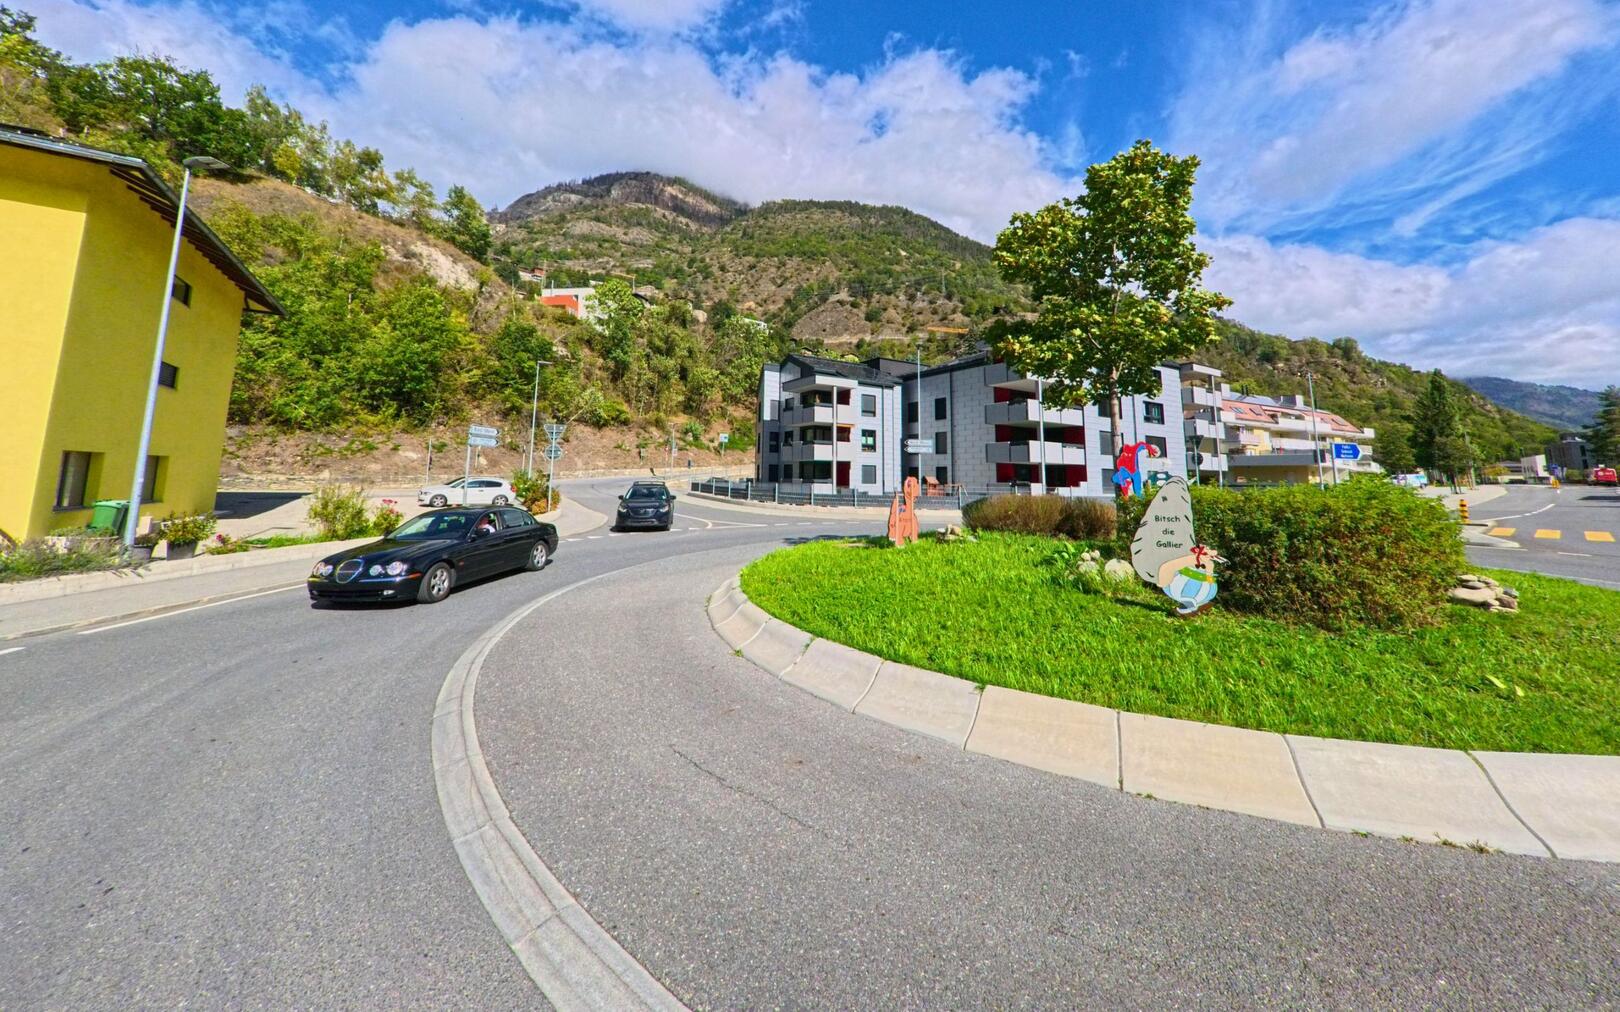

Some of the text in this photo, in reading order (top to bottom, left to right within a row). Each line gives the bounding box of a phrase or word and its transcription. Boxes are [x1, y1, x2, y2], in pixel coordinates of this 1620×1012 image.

[1154, 514, 1181, 523] Bitsch
[1162, 528, 1175, 536] die
[1155, 540, 1183, 549] Gallier
